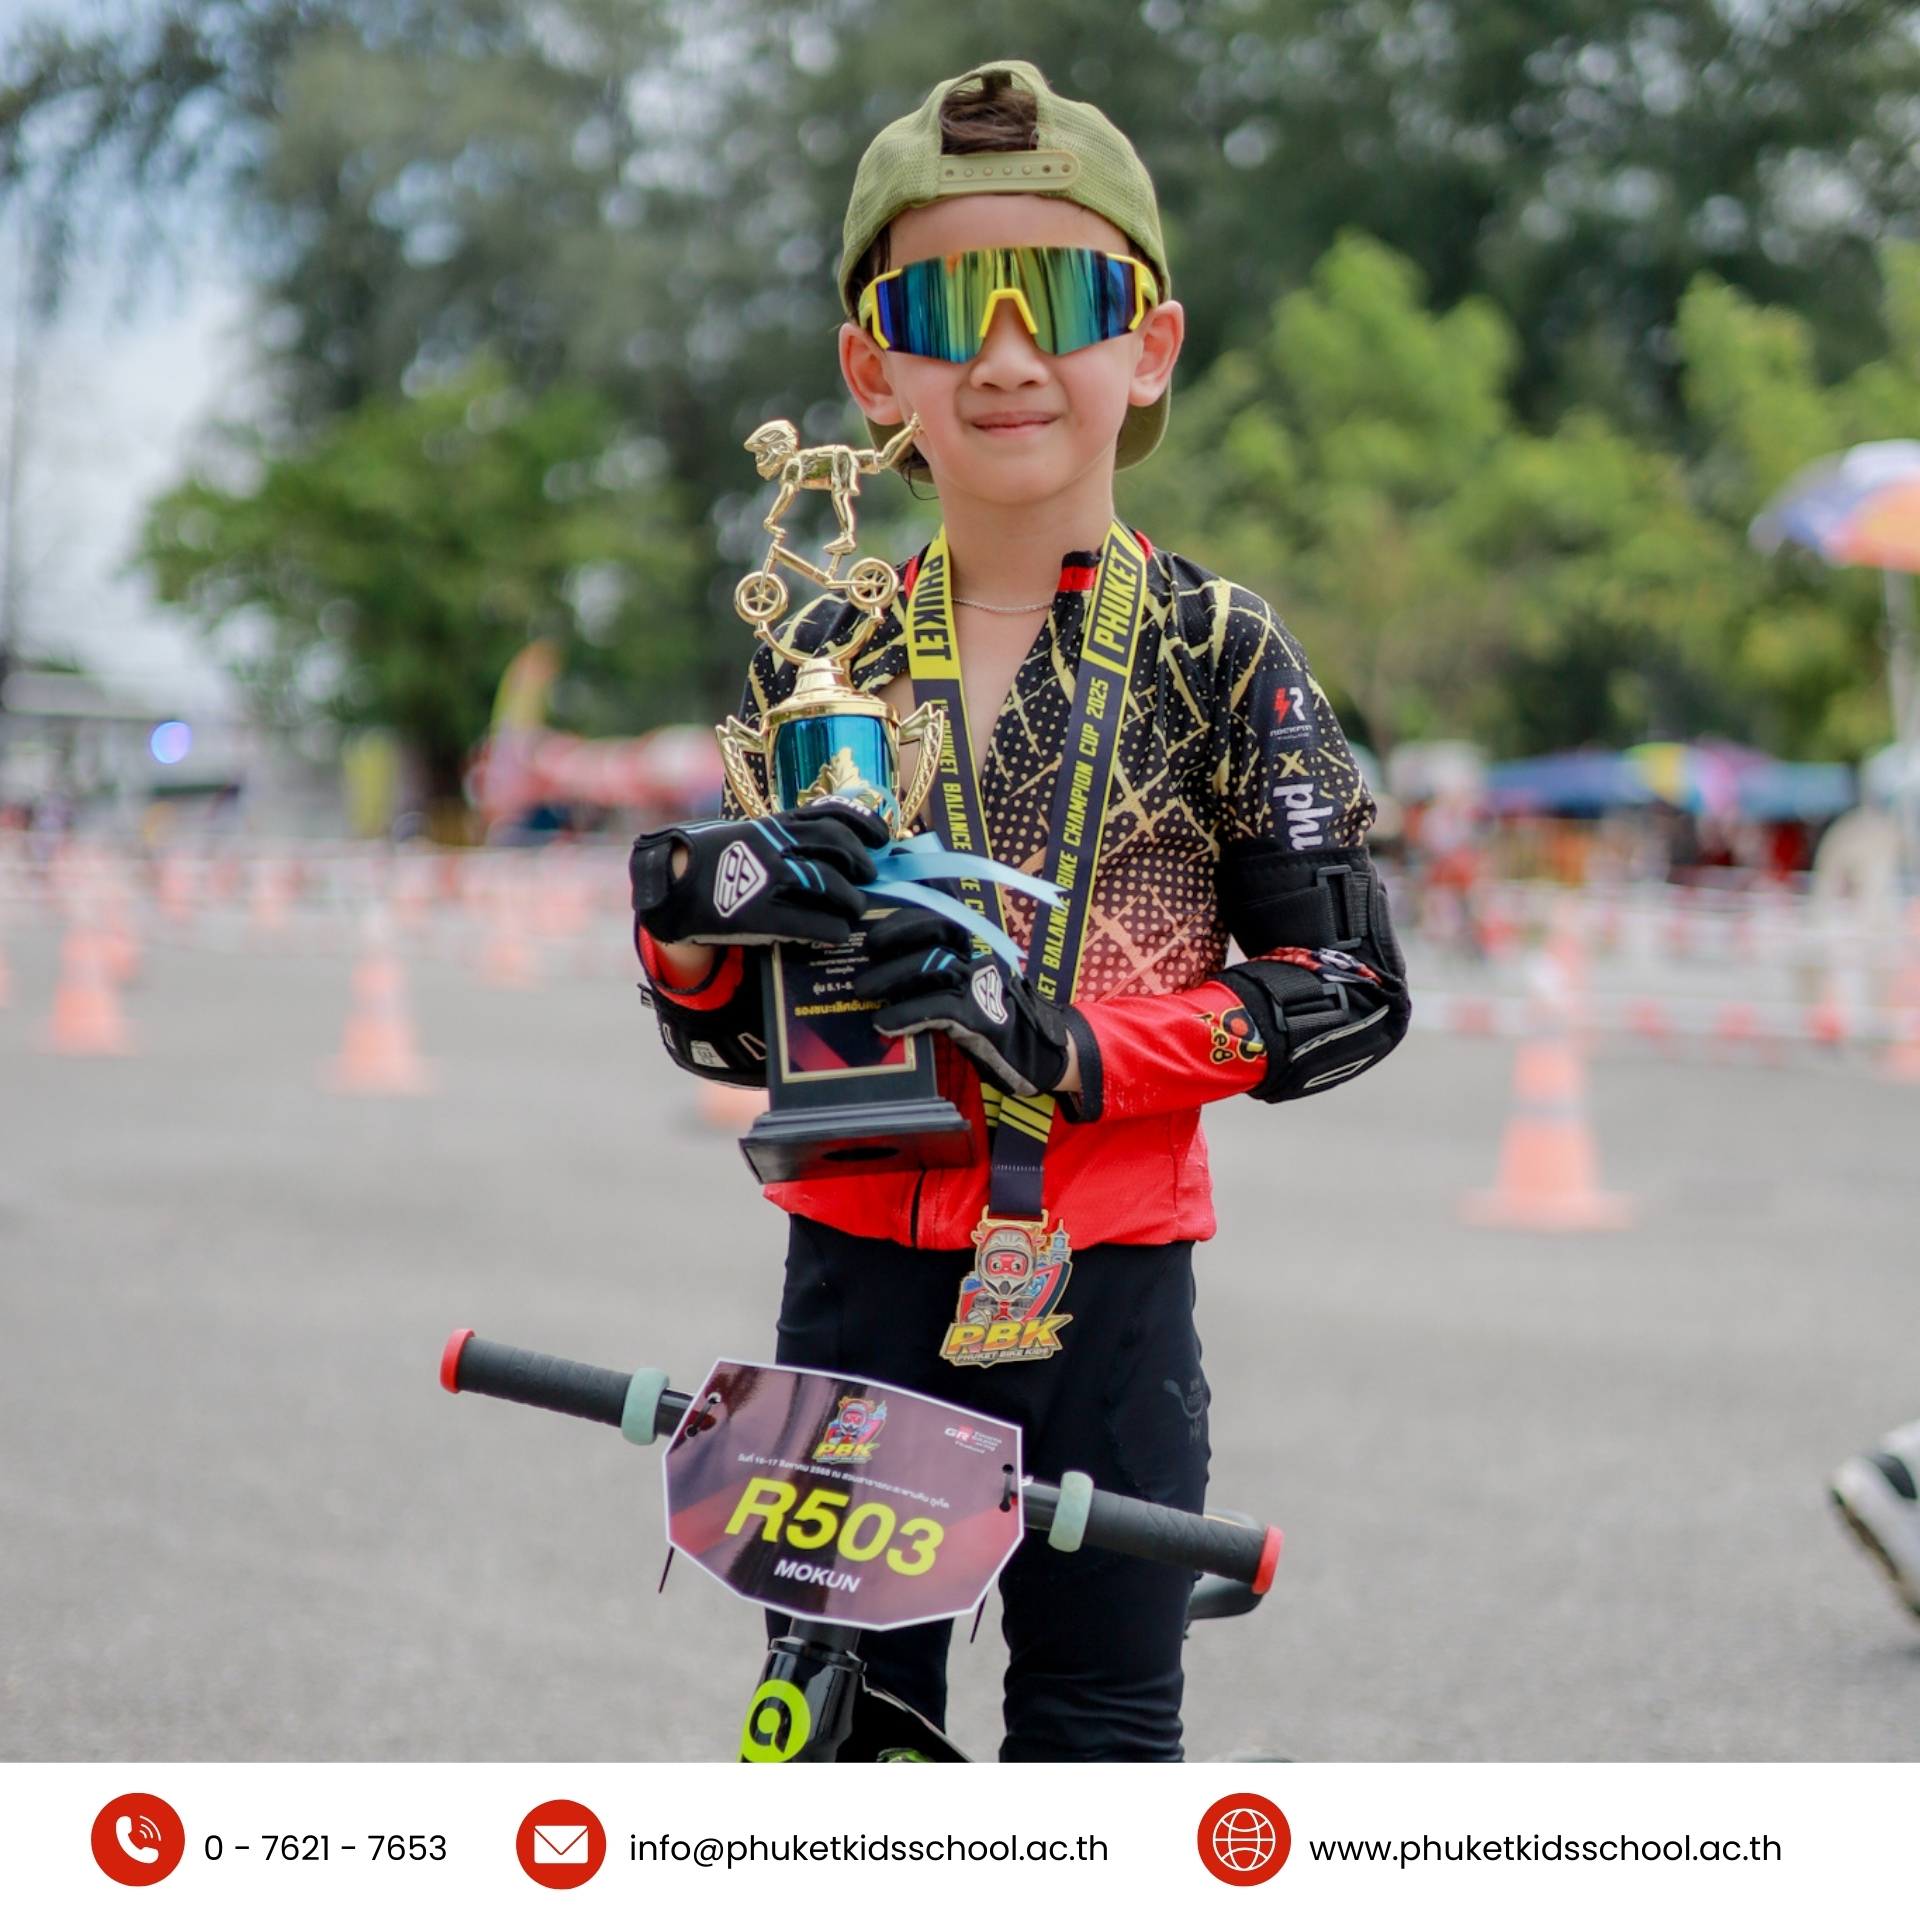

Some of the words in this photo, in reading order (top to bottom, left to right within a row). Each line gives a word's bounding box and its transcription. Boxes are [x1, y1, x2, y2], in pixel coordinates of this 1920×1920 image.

[913, 554, 952, 661] PHUKET
[1093, 544, 1138, 654] PHUKET
[1086, 676, 1109, 720] 2025
[1079, 722, 1100, 757] CUP
[942, 782, 972, 851] BALANCE
[1063, 760, 1094, 847] CHAMPION
[1056, 850, 1078, 890] BIKE
[946, 1319, 1063, 1354] PBK
[1000, 1350, 1023, 1359] BIKE
[1025, 1347, 1050, 1356] KIDS
[815, 1443, 879, 1458] PBK
[724, 1477, 945, 1576] R503
[774, 1559, 861, 1593] MOKUN
